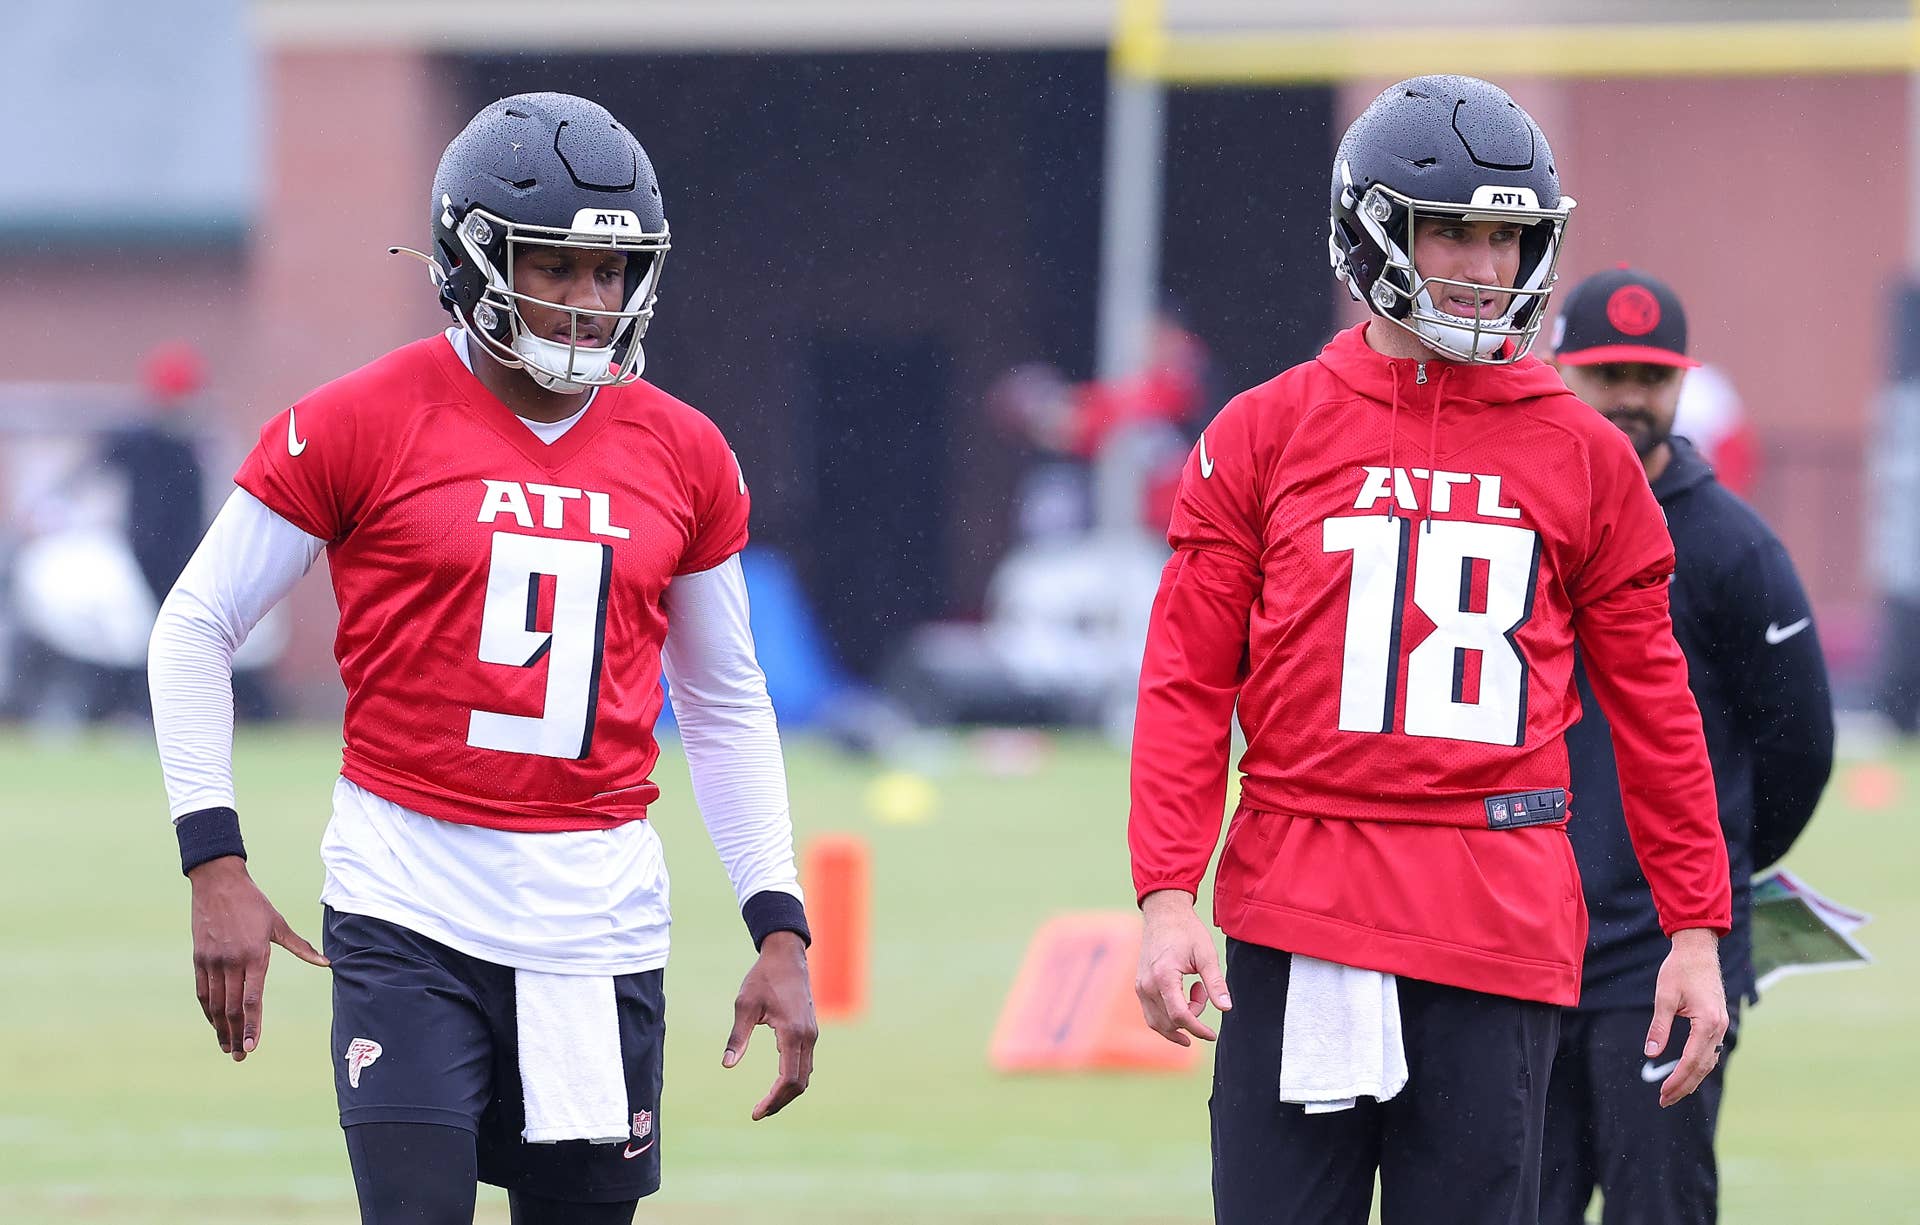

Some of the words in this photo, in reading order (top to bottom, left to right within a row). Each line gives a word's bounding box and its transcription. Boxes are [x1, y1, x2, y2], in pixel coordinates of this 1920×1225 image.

[594, 214, 629, 226] ATL
[1491, 193, 1526, 206] ATL
[477, 479, 631, 539] ATL
[1353, 466, 1521, 519] ATL
[466, 531, 613, 760] 9
[1323, 515, 1543, 747] 18
[636, 1121, 650, 1134] NFL
